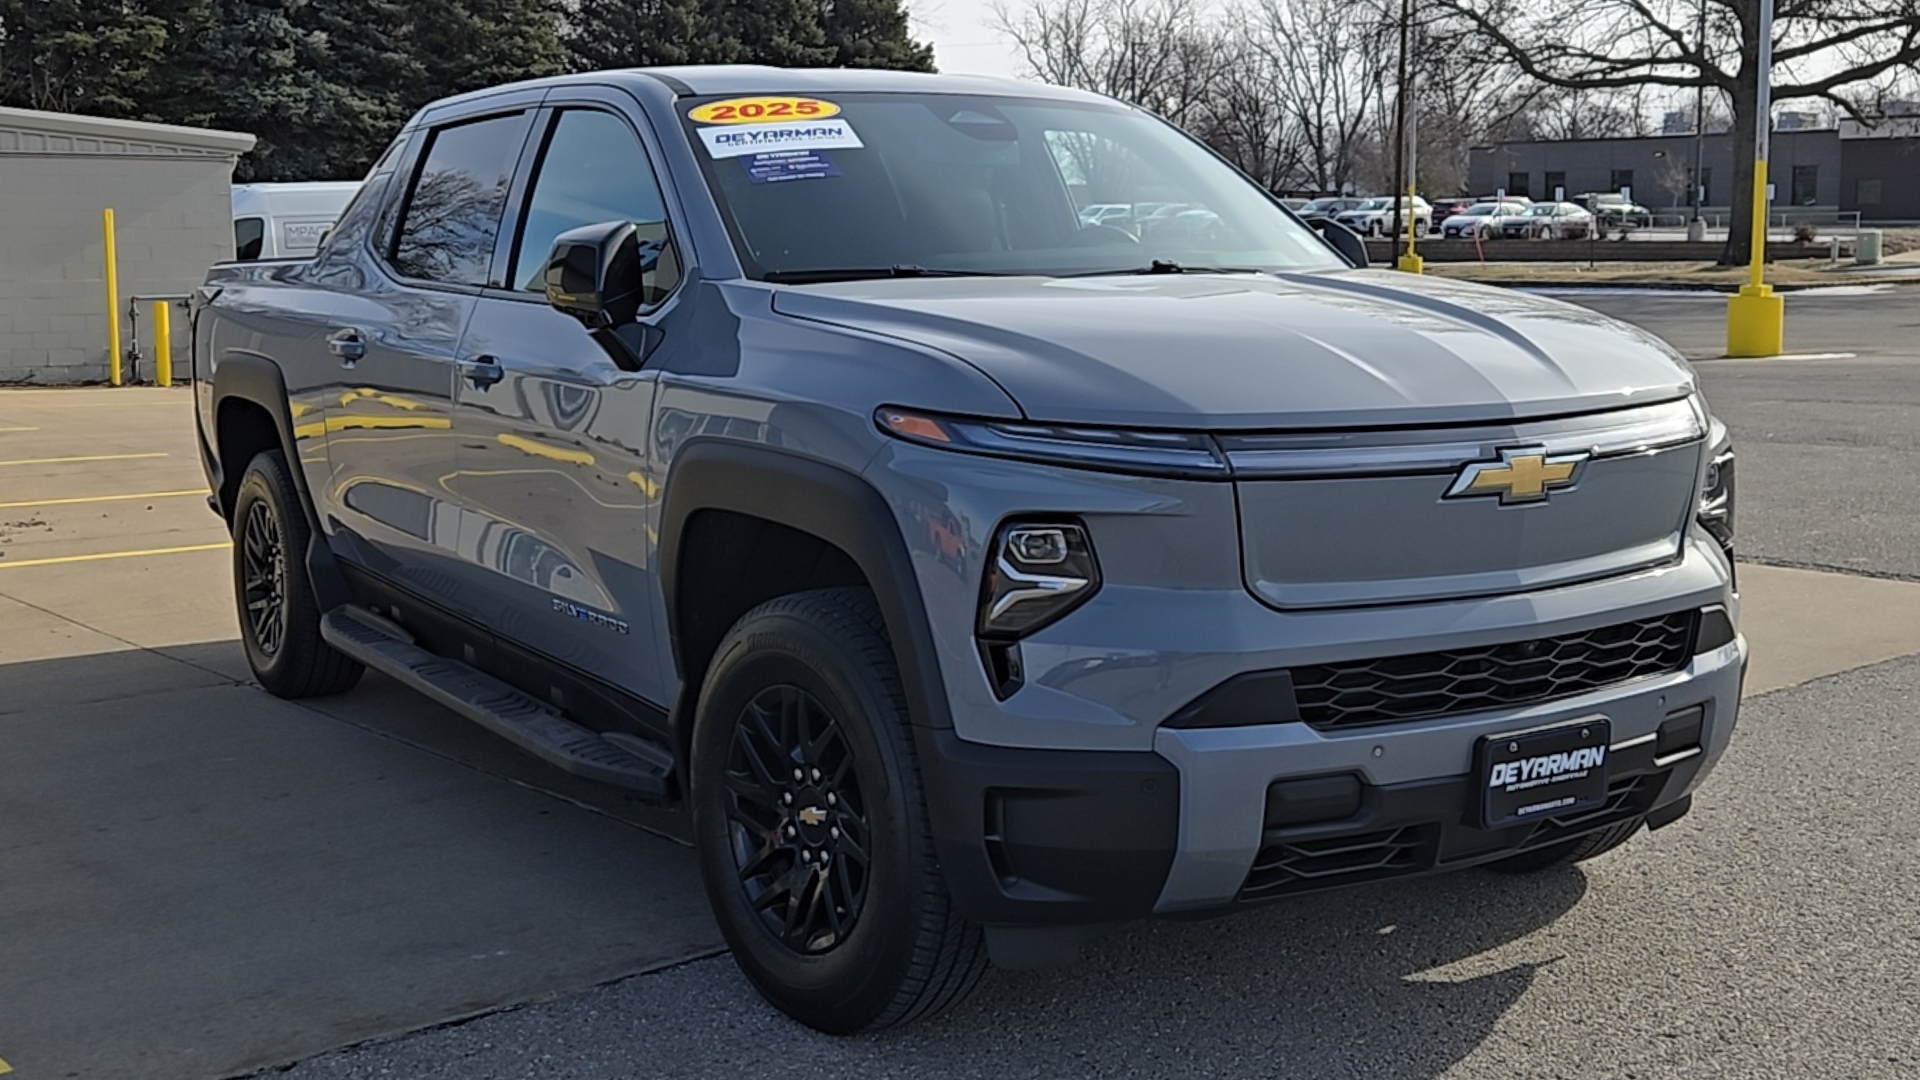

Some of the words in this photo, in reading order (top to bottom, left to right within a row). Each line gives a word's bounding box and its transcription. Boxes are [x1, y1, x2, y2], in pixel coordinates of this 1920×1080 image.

[710, 101, 822, 120] 2025
[715, 127, 843, 144] DEYARMAN
[552, 598, 628, 632] SILVERADO
[1489, 745, 1606, 788] DEYARMAN
